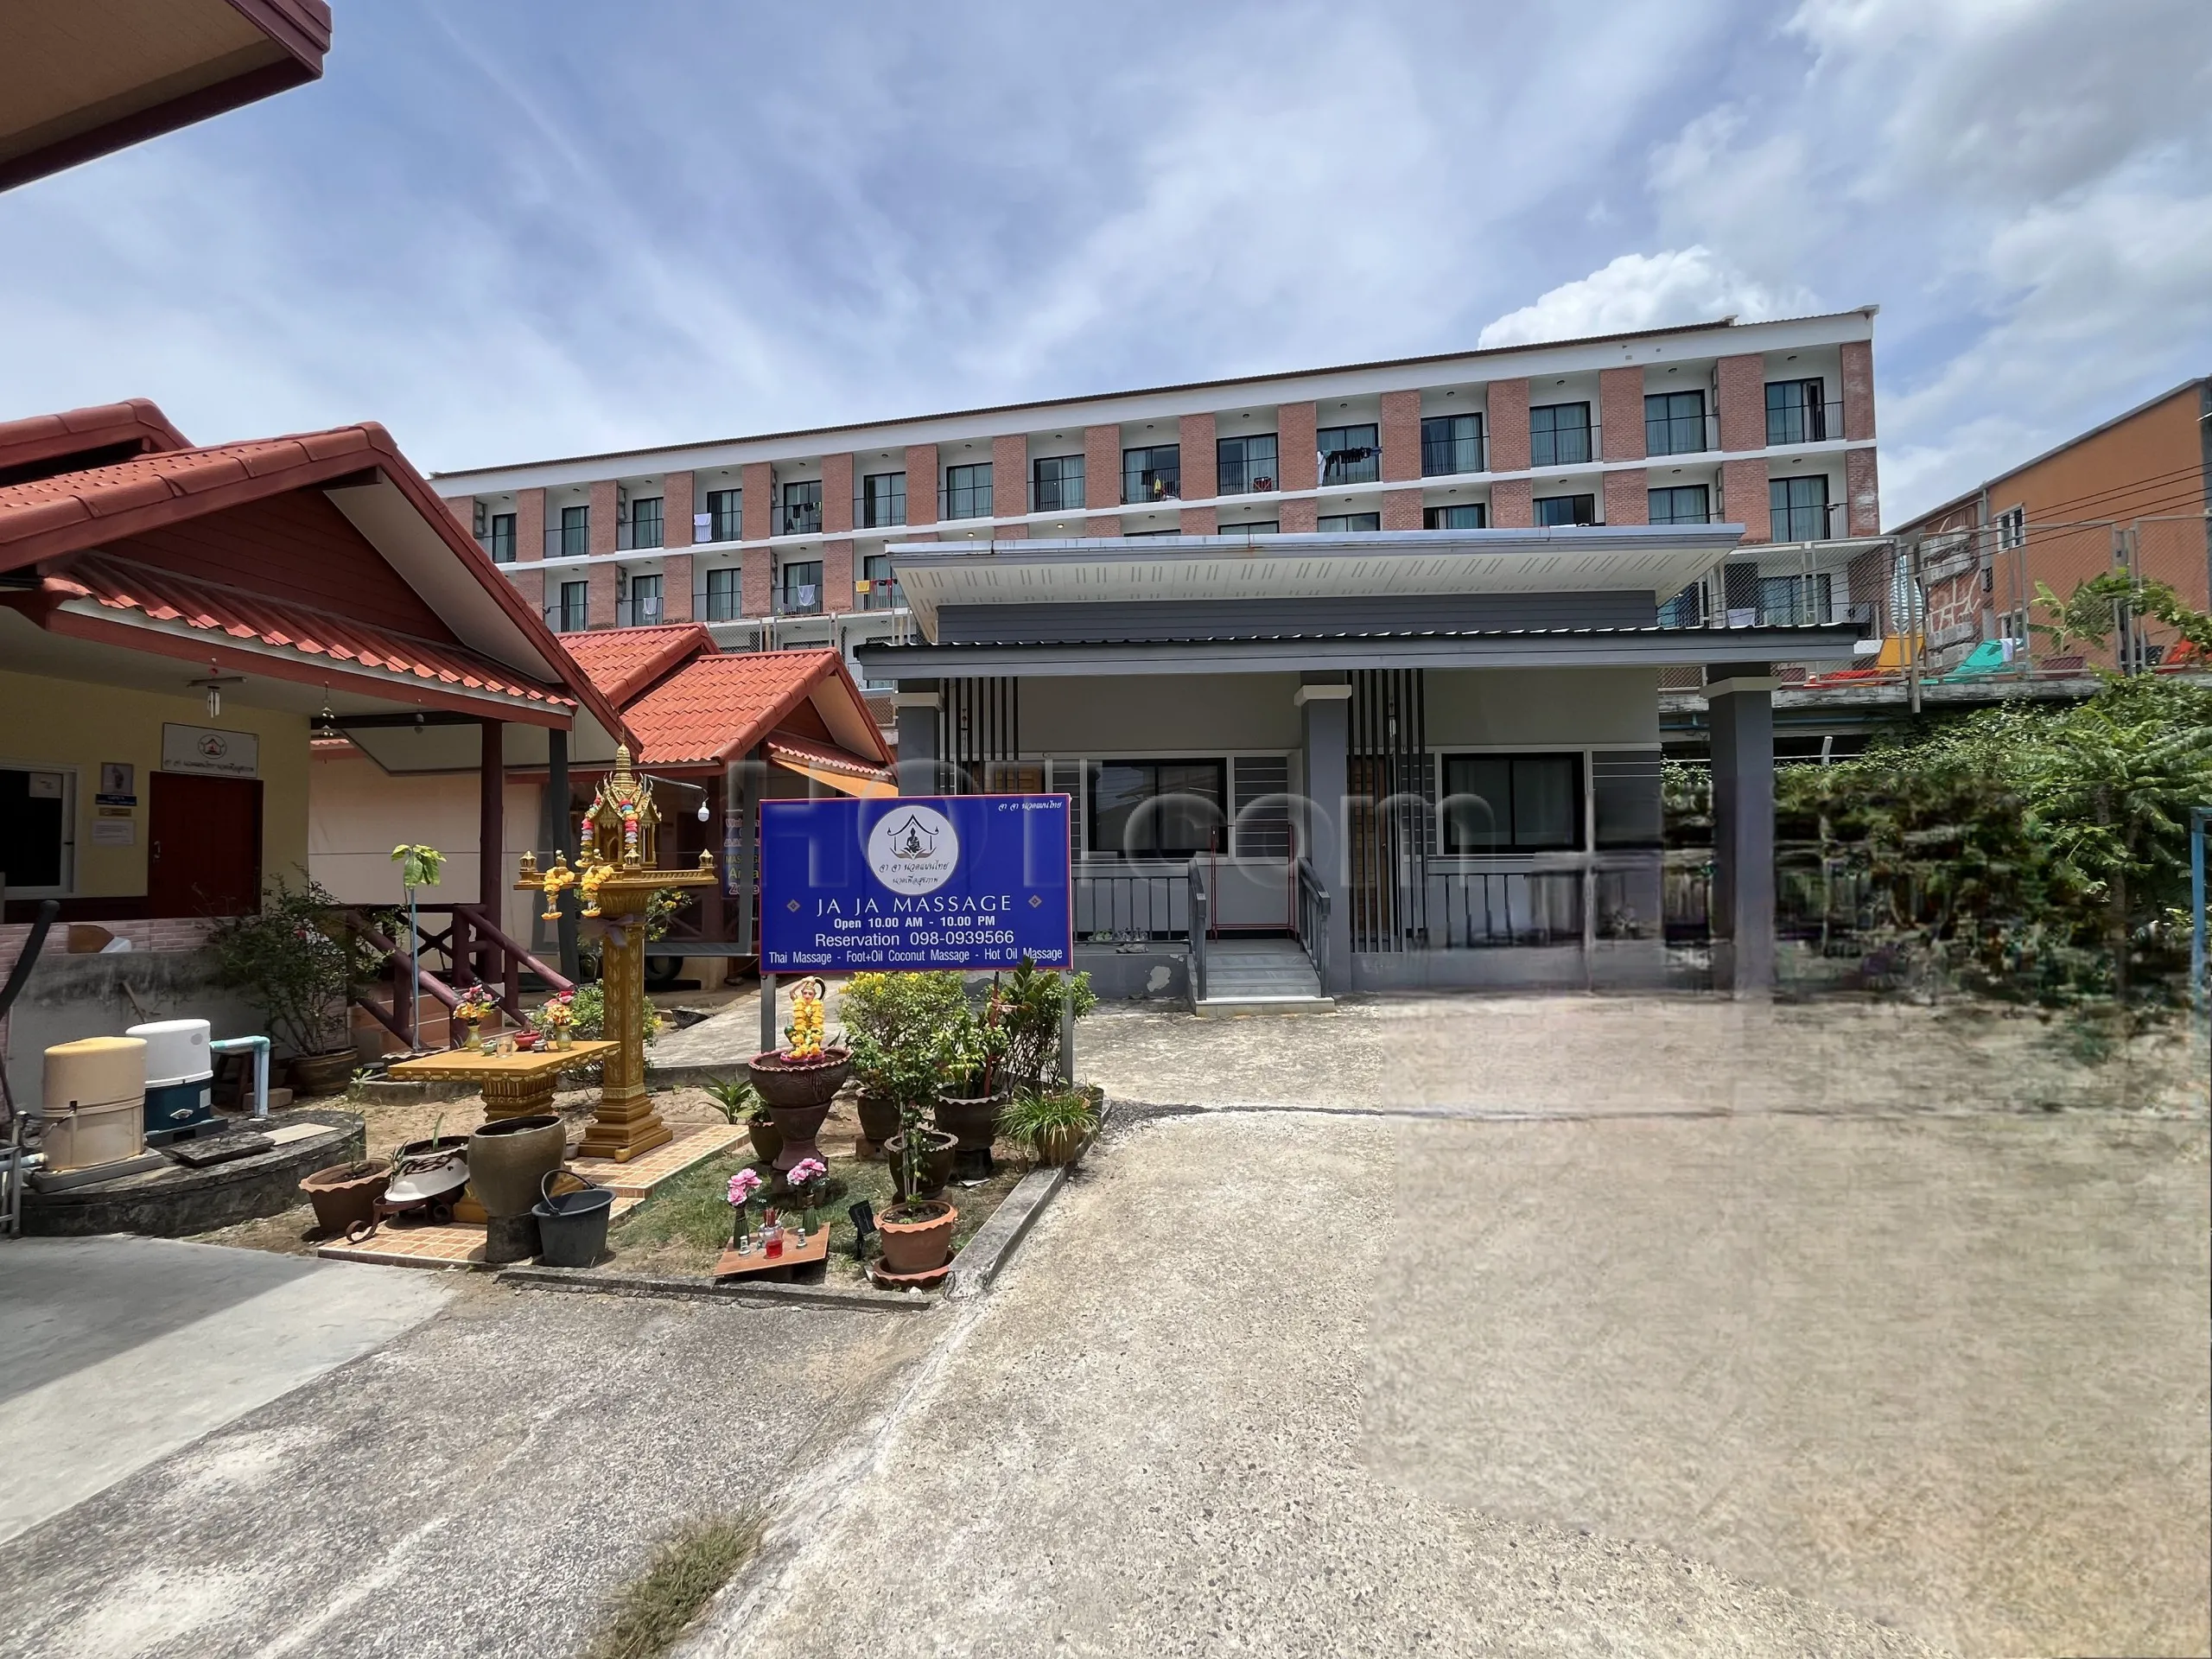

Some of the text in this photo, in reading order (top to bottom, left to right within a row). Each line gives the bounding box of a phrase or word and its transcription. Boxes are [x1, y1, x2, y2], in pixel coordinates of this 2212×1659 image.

[817, 895, 1012, 917] JA JA MASSAGE
[834, 918, 861, 931] Open
[868, 918, 899, 928] 10.00
[905, 918, 923, 927] AM
[939, 916, 971, 927] 10.00
[977, 916, 995, 926] PM
[815, 931, 1014, 947] Reservation 098-0939566
[769, 951, 787, 964] Thai
[792, 951, 832, 965] Massage
[846, 950, 883, 963] Foot+Oil
[888, 950, 925, 962] Coconut
[930, 950, 969, 963] Massage
[984, 949, 1001, 961] Hot
[1006, 949, 1018, 960] Oil
[1022, 948, 1063, 961] Massage
